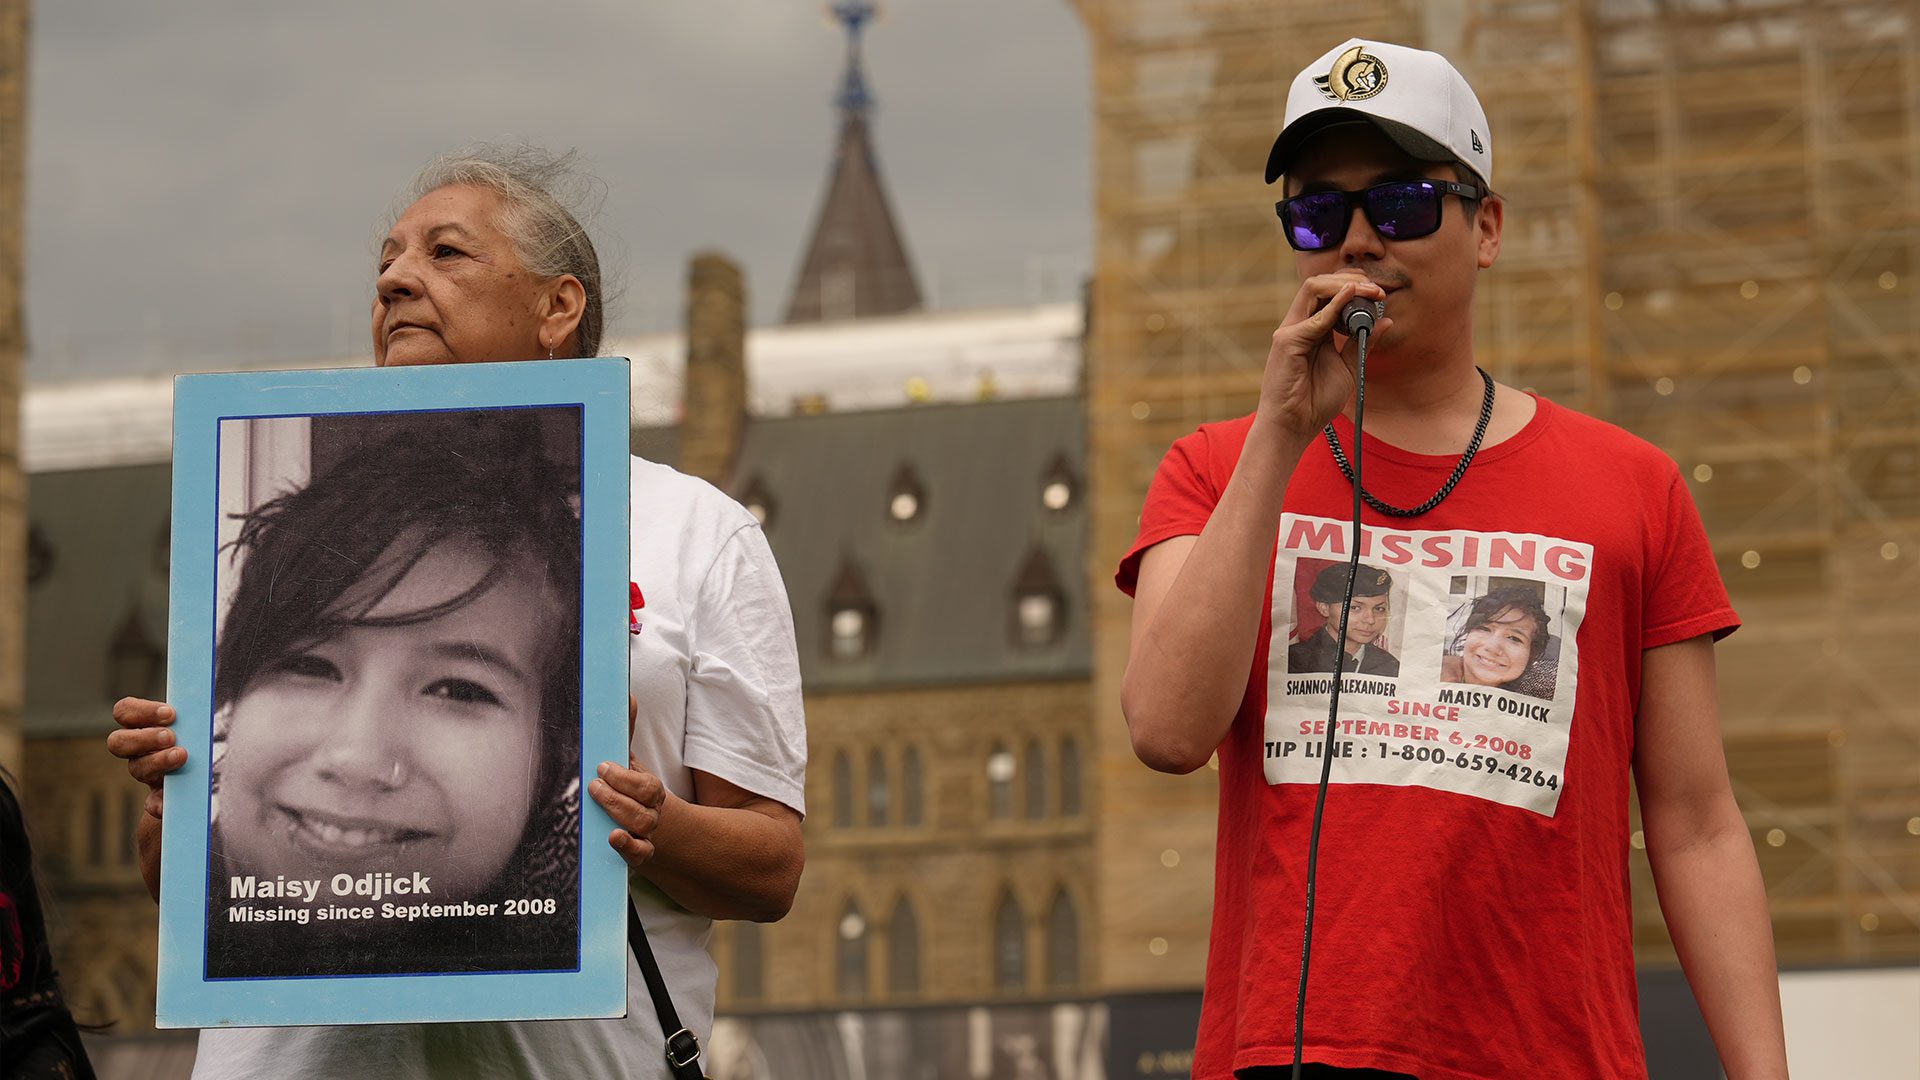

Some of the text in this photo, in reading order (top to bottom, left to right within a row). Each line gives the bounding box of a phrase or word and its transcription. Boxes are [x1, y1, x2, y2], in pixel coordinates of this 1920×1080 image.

[1284, 519, 1587, 581] MISSING
[1286, 679, 1397, 698] SHANNON ALEXANDER
[1387, 699, 1461, 723] SINCE
[1438, 689, 1551, 723] MAISY ODJICK
[1448, 730, 1532, 760] 6,2008
[1265, 741, 1297, 759] TIP
[1378, 741, 1558, 791] 1-800-659-4264
[229, 872, 432, 902] Maisy Odjick
[228, 898, 557, 924] Missing since September 2008
